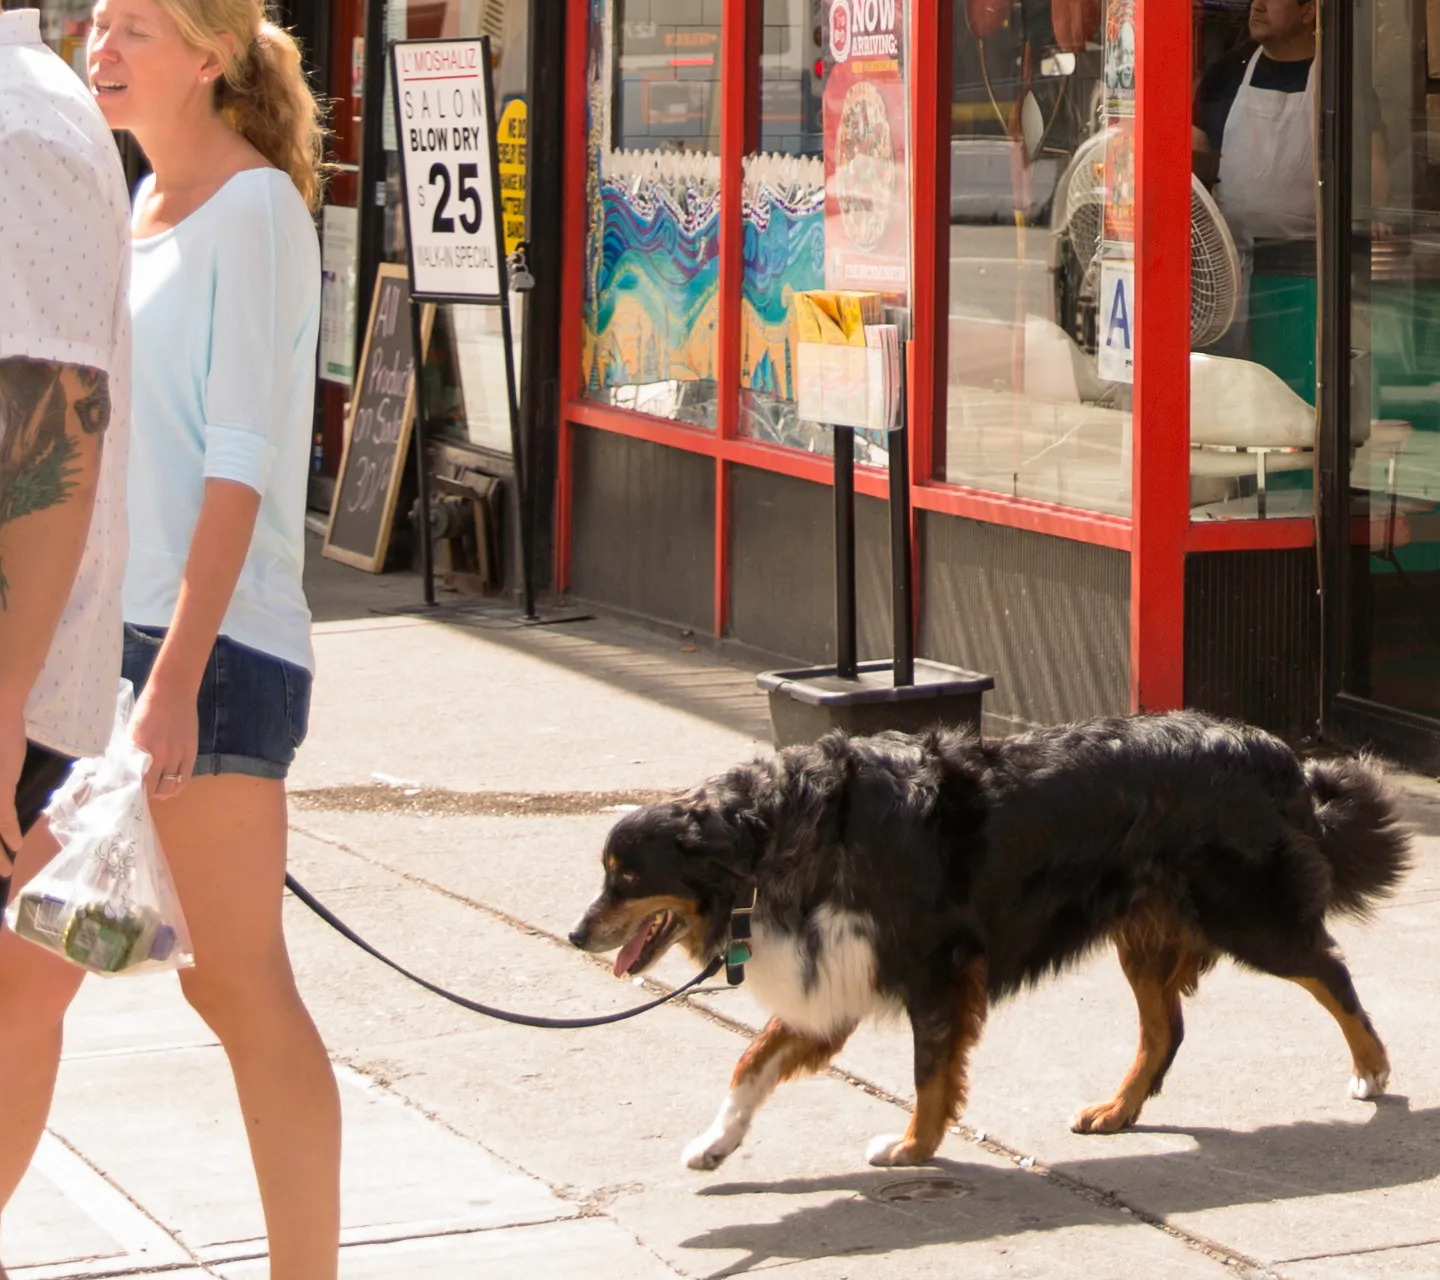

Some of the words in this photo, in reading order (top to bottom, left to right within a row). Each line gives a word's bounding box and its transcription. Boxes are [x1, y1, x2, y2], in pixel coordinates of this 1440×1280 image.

[851, 34, 898, 58] ARRIVING:
[404, 89, 483, 119] SALON
[410, 128, 448, 153] BLOW
[453, 126, 479, 152] DRY
[416, 245, 454, 270] WALK-IN
[455, 244, 495, 269] SPECIAL
[1105, 278, 1131, 350] A
